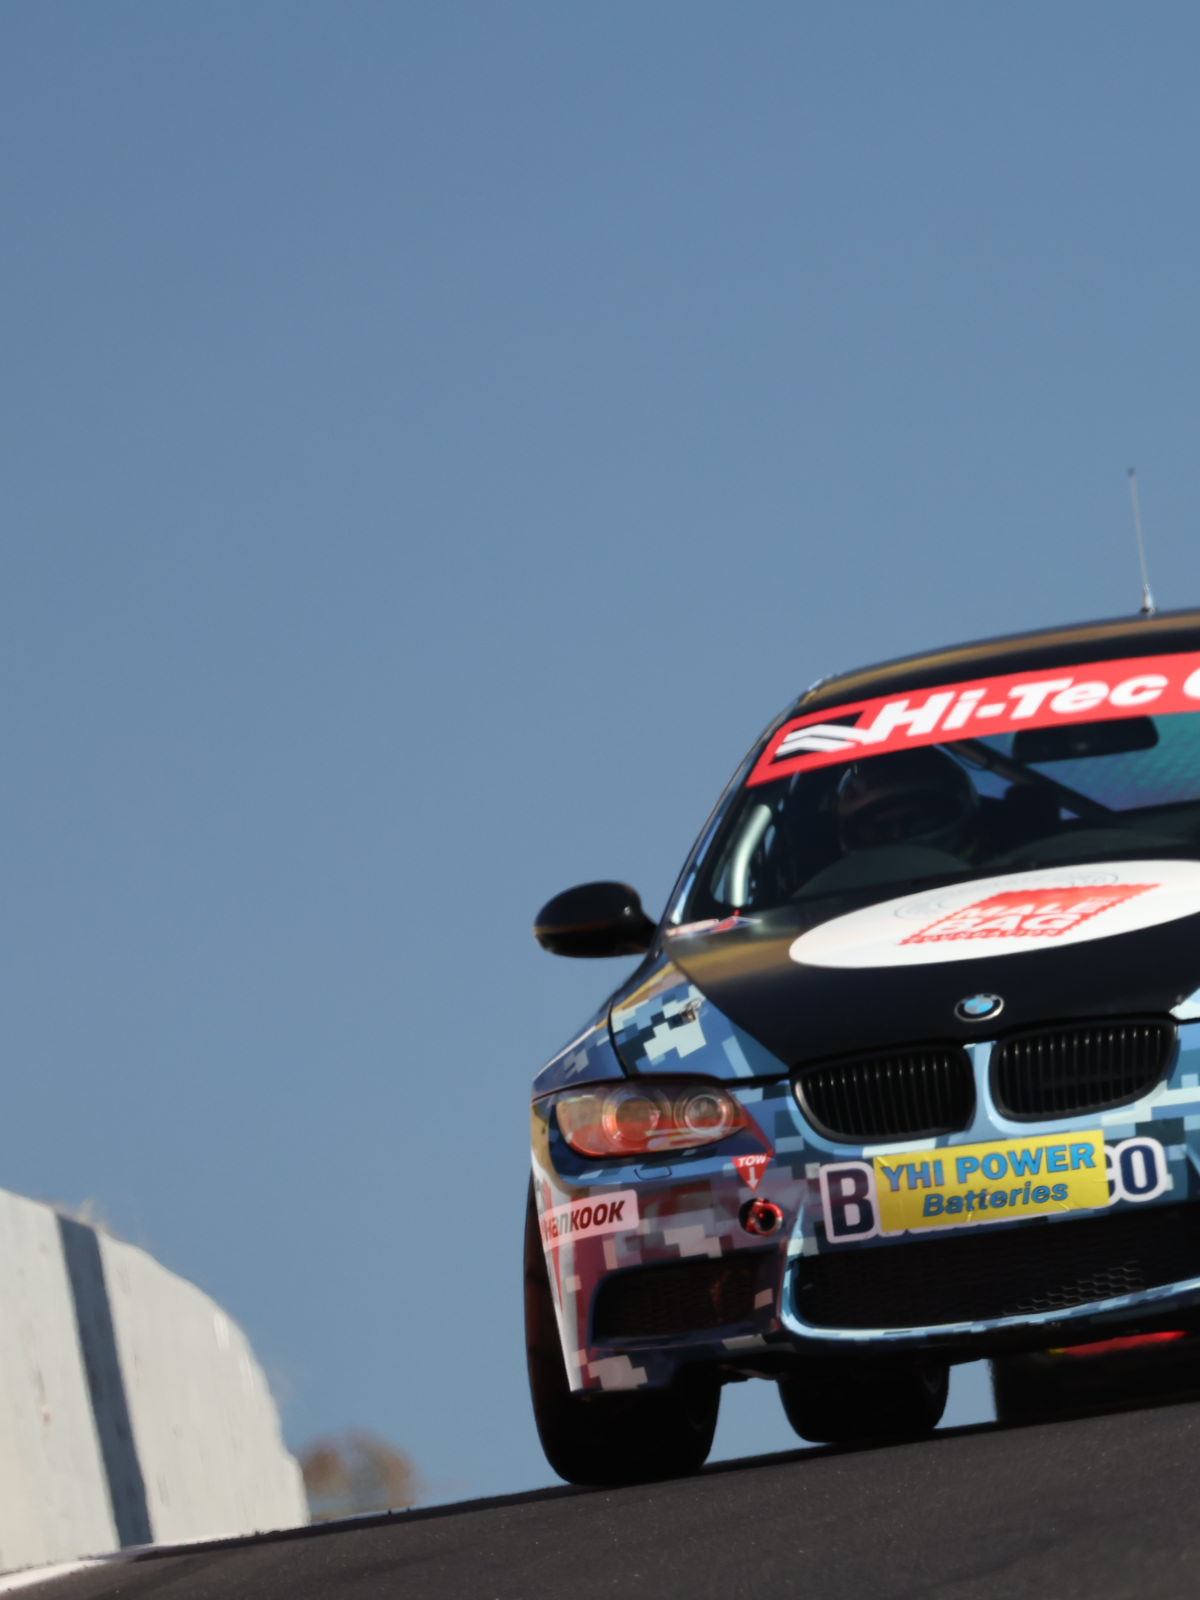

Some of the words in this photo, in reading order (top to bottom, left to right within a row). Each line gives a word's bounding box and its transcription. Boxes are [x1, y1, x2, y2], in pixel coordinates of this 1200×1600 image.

[860, 674, 1169, 746] Hi-Tec
[923, 914, 1083, 932] BAG
[737, 1154, 767, 1168] TOW
[880, 1160, 945, 1192] YHI
[955, 1142, 1097, 1184] POWER
[923, 1182, 1069, 1218] Batteries
